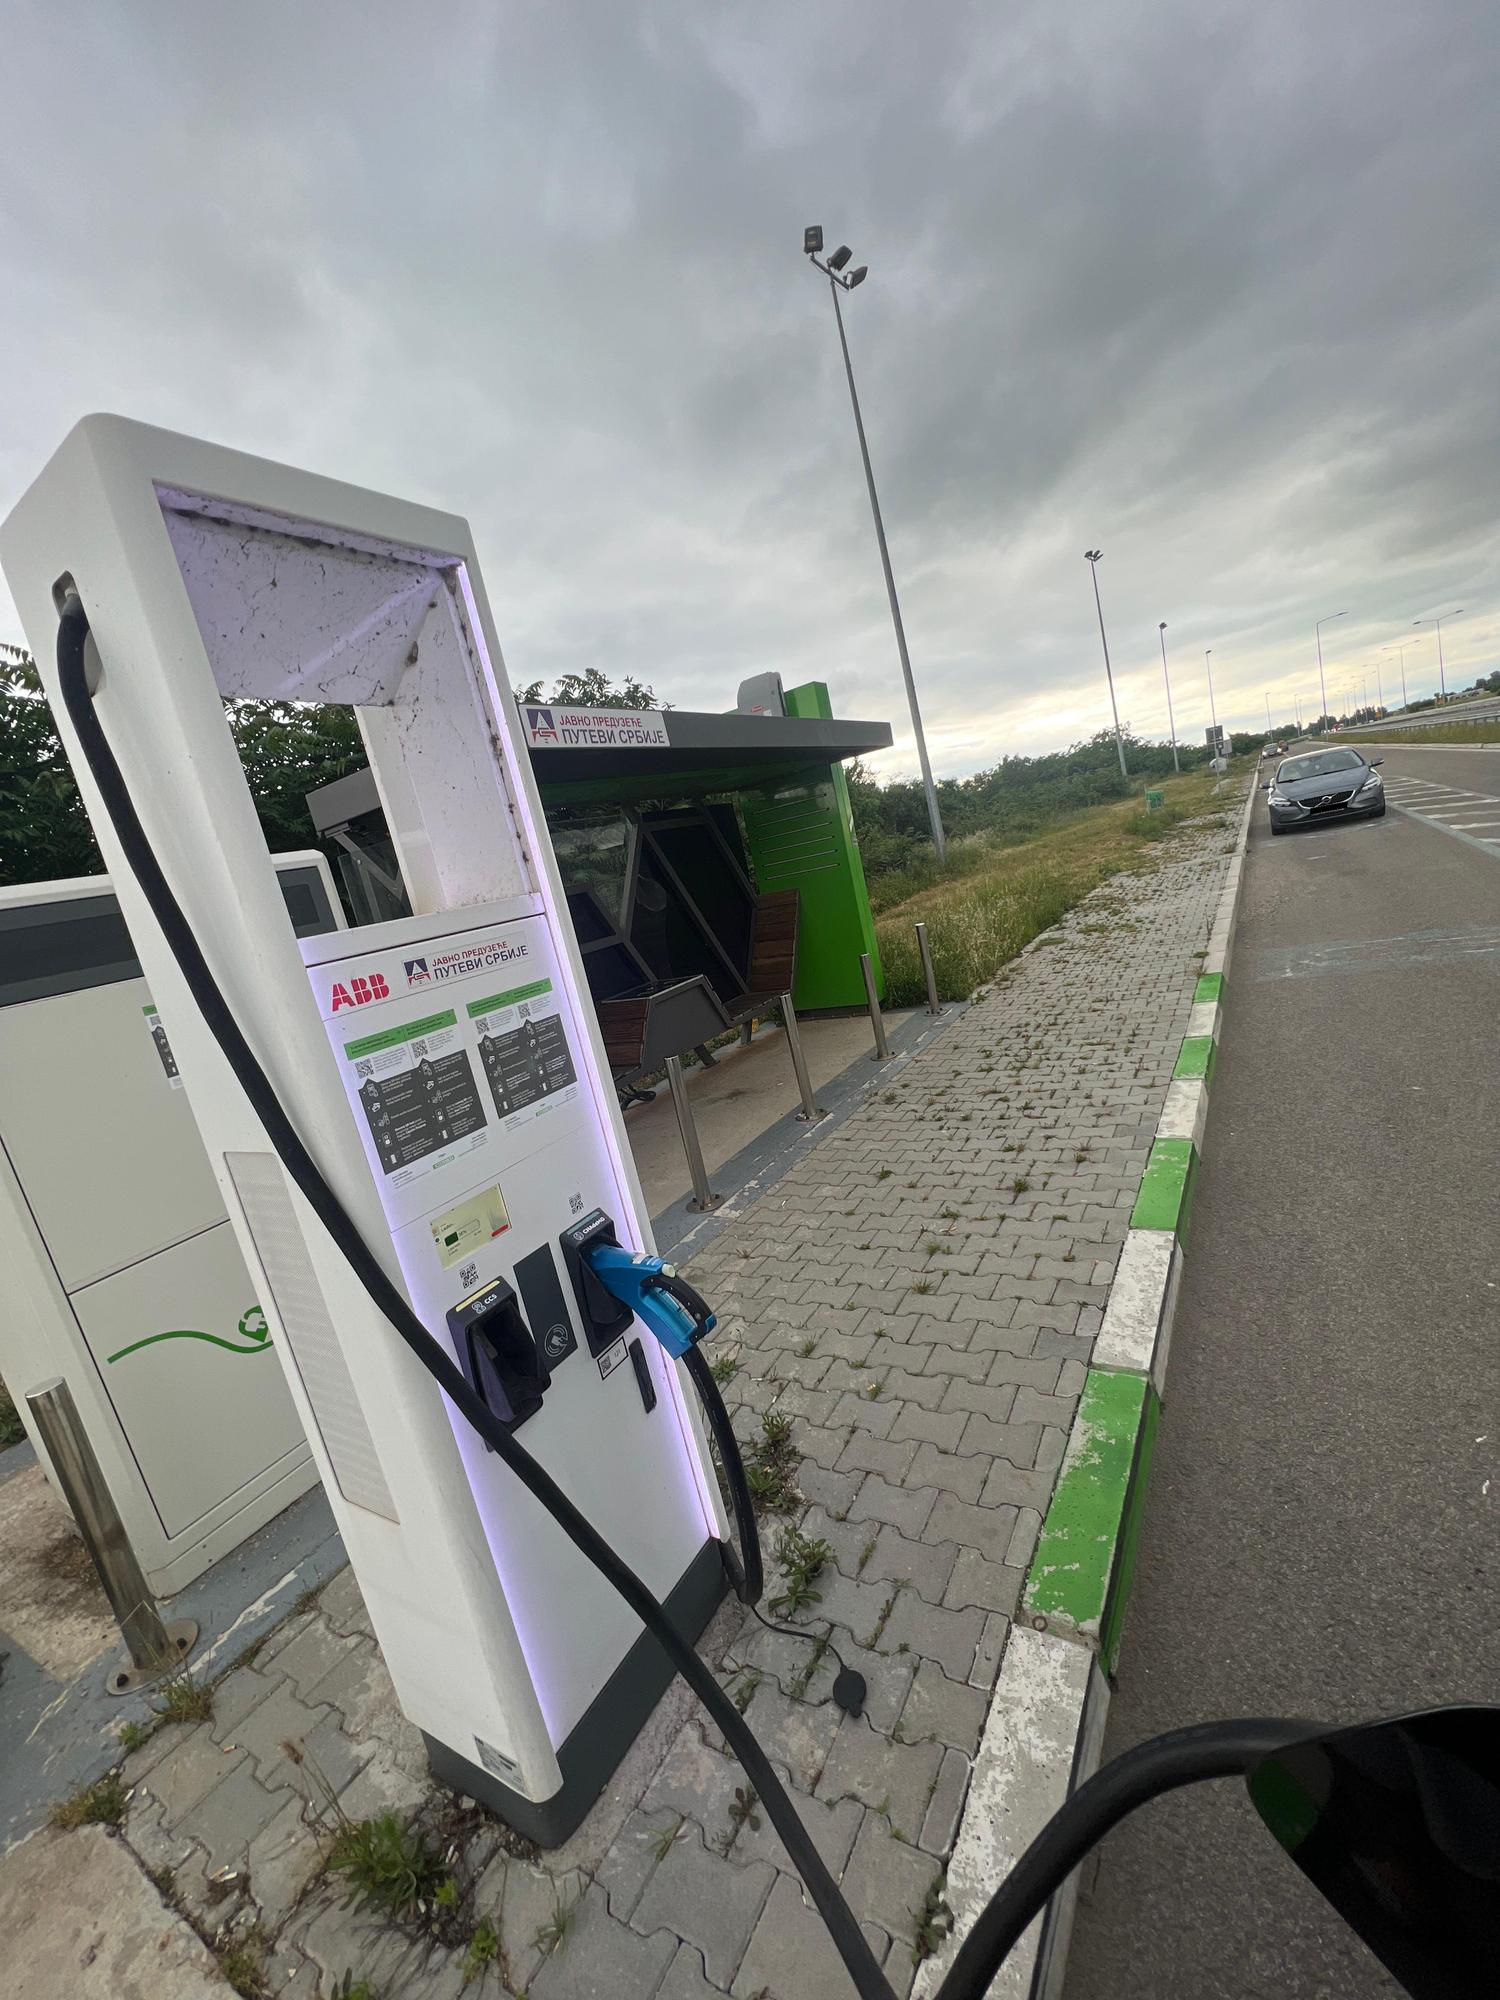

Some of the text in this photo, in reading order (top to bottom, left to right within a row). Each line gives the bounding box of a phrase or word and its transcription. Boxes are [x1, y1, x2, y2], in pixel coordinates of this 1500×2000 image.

[559, 715, 643, 728] ЈАВНО ПРЕДУЗЕЋЕ
[562, 729, 665, 744] ПУТЕВИ СРБИЈЕ
[432, 941, 508, 967] ЈАВНО ПРЕДУЗЕЋЕ
[434, 945, 529, 980] ПУТЕВИ СРБИЈЕ
[332, 973, 390, 1012] ABB
[484, 1293, 497, 1304] CCS
